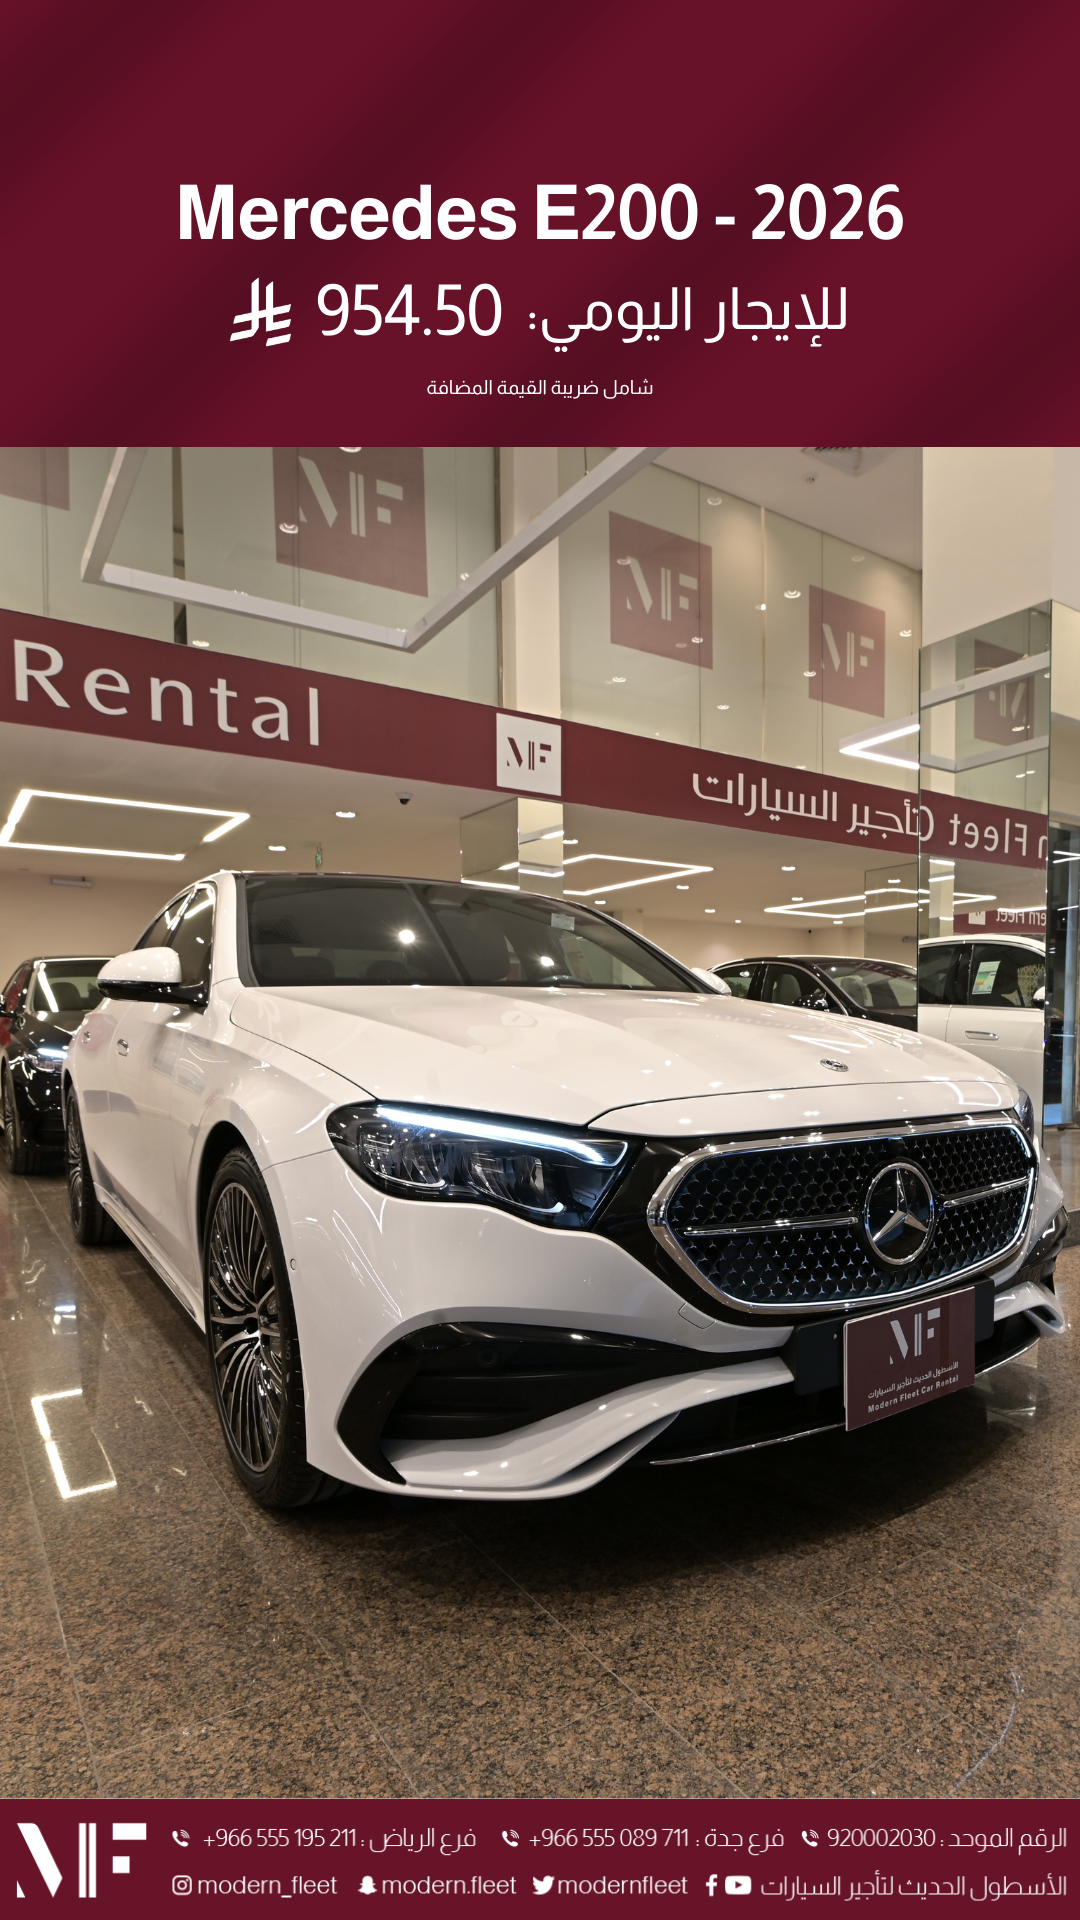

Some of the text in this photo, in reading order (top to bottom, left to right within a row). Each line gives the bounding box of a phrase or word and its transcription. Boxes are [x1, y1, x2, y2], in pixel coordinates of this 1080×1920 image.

[13, 638, 320, 746] Rental
[692, 773, 837, 822] السيارات
[868, 1383, 896, 1399] السيارات
[868, 1374, 959, 1413] Modern Fleet Car Rental
